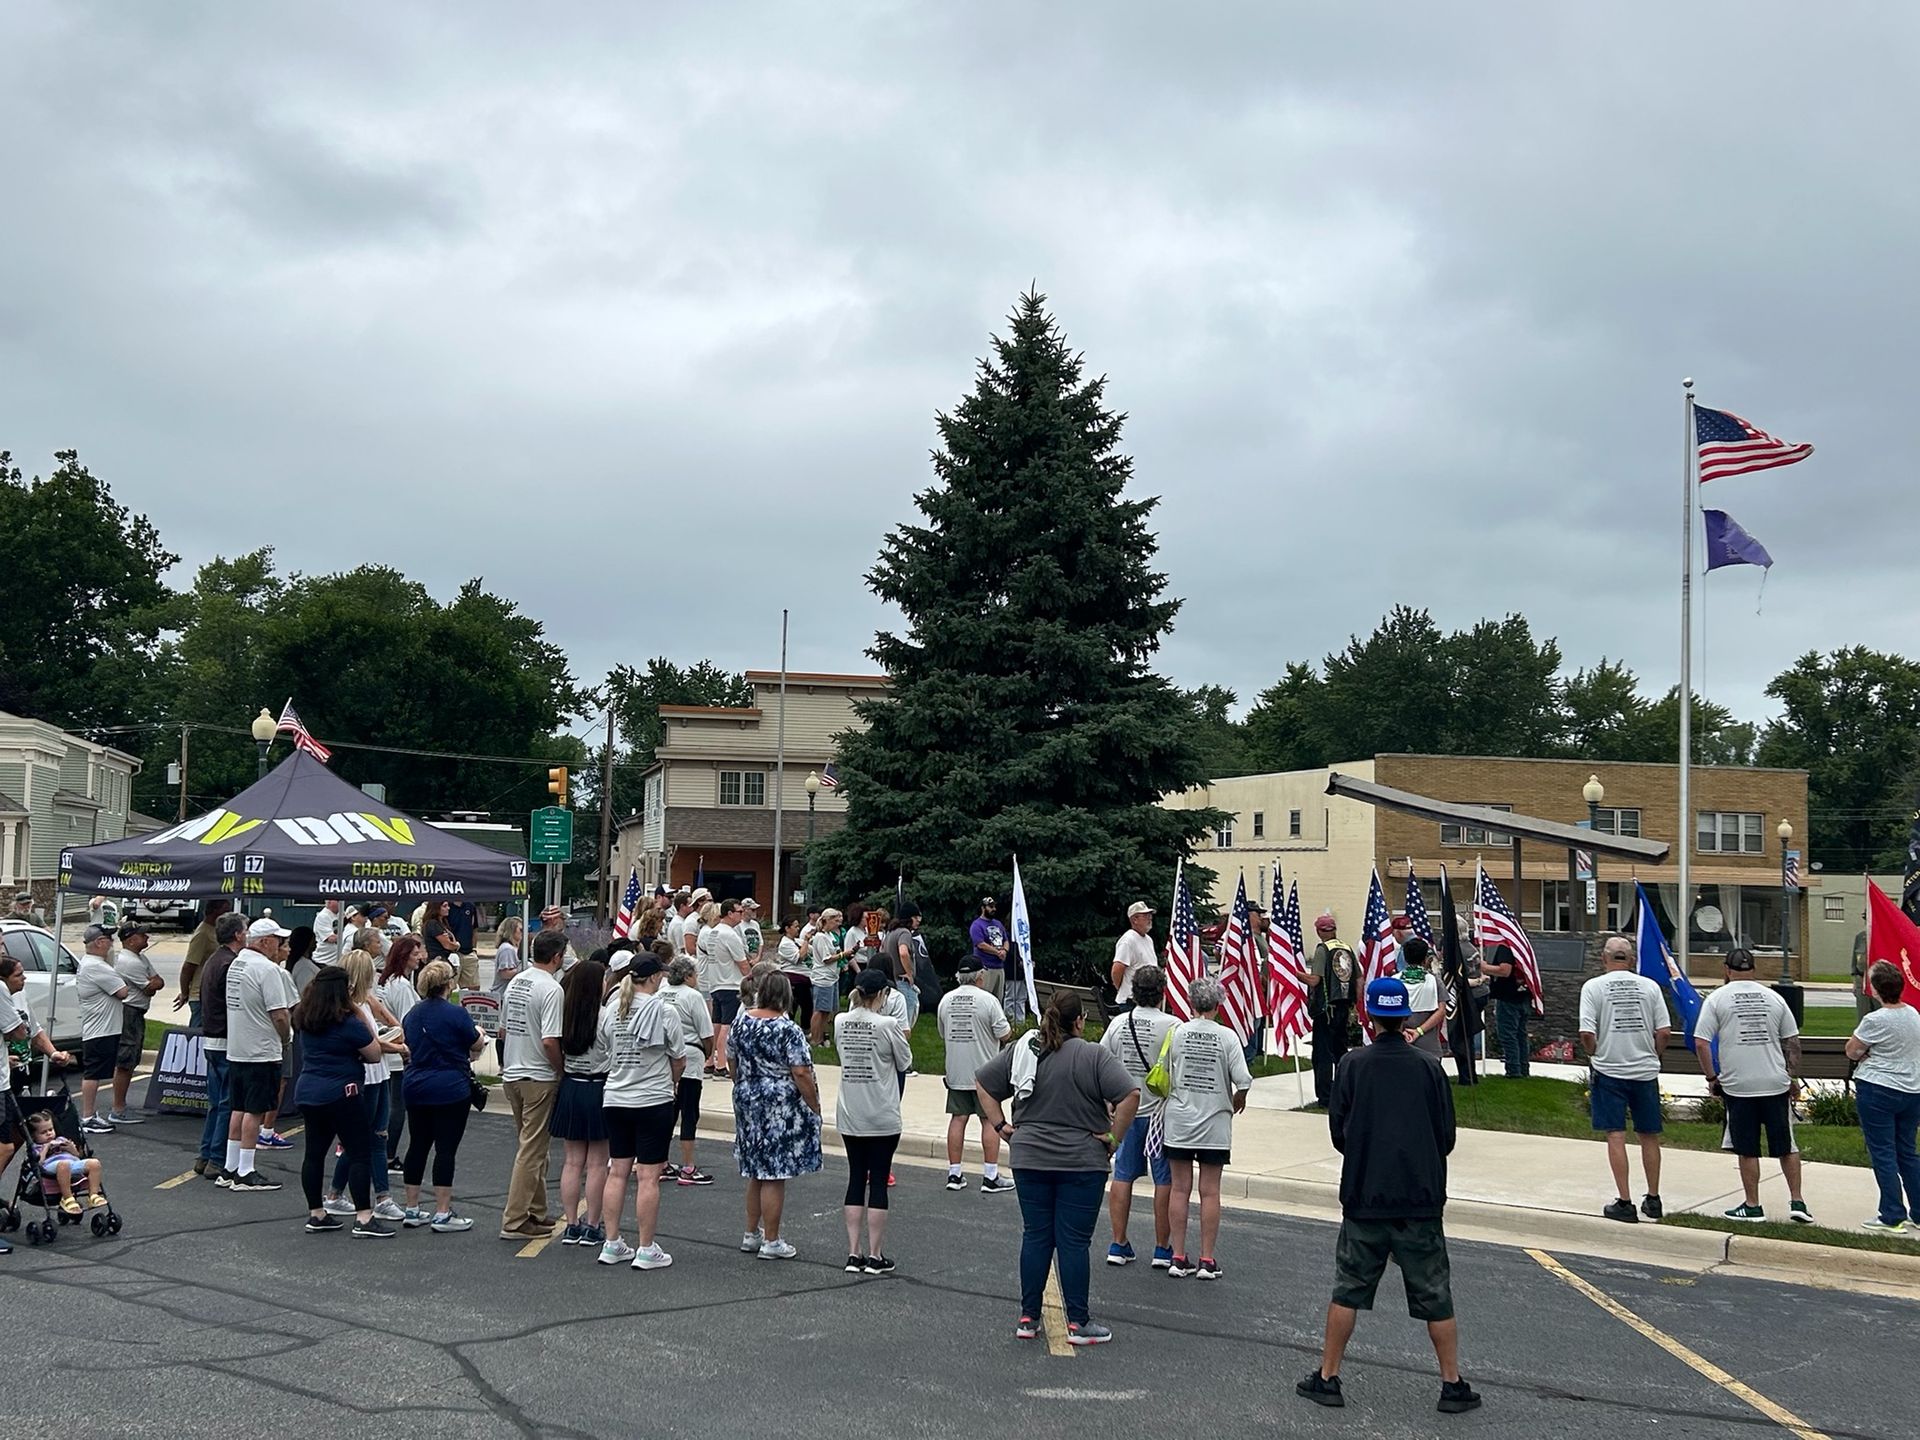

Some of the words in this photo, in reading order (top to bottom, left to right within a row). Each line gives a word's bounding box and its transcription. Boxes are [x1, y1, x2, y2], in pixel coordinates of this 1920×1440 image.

[272, 812, 416, 846] DAV
[62, 854, 72, 868] 17
[119, 862, 162, 875] CHAPTER
[225, 855, 235, 872] 17
[245, 856, 263, 872] 17
[511, 861, 526, 876] 17
[352, 862, 416, 877] CHAPTER
[421, 864, 436, 877] 17
[60, 873, 71, 886] IN
[148, 879, 191, 892] INDIANA
[221, 877, 235, 892] IN
[243, 877, 264, 894] IN
[1904, 869, 1920, 888] VETER
[318, 878, 402, 896] HAMMOND,
[405, 880, 465, 894] INDIANA
[511, 880, 527, 895] IN
[1186, 1031, 1218, 1041] SPONSORS
[160, 1033, 208, 1077] DA
